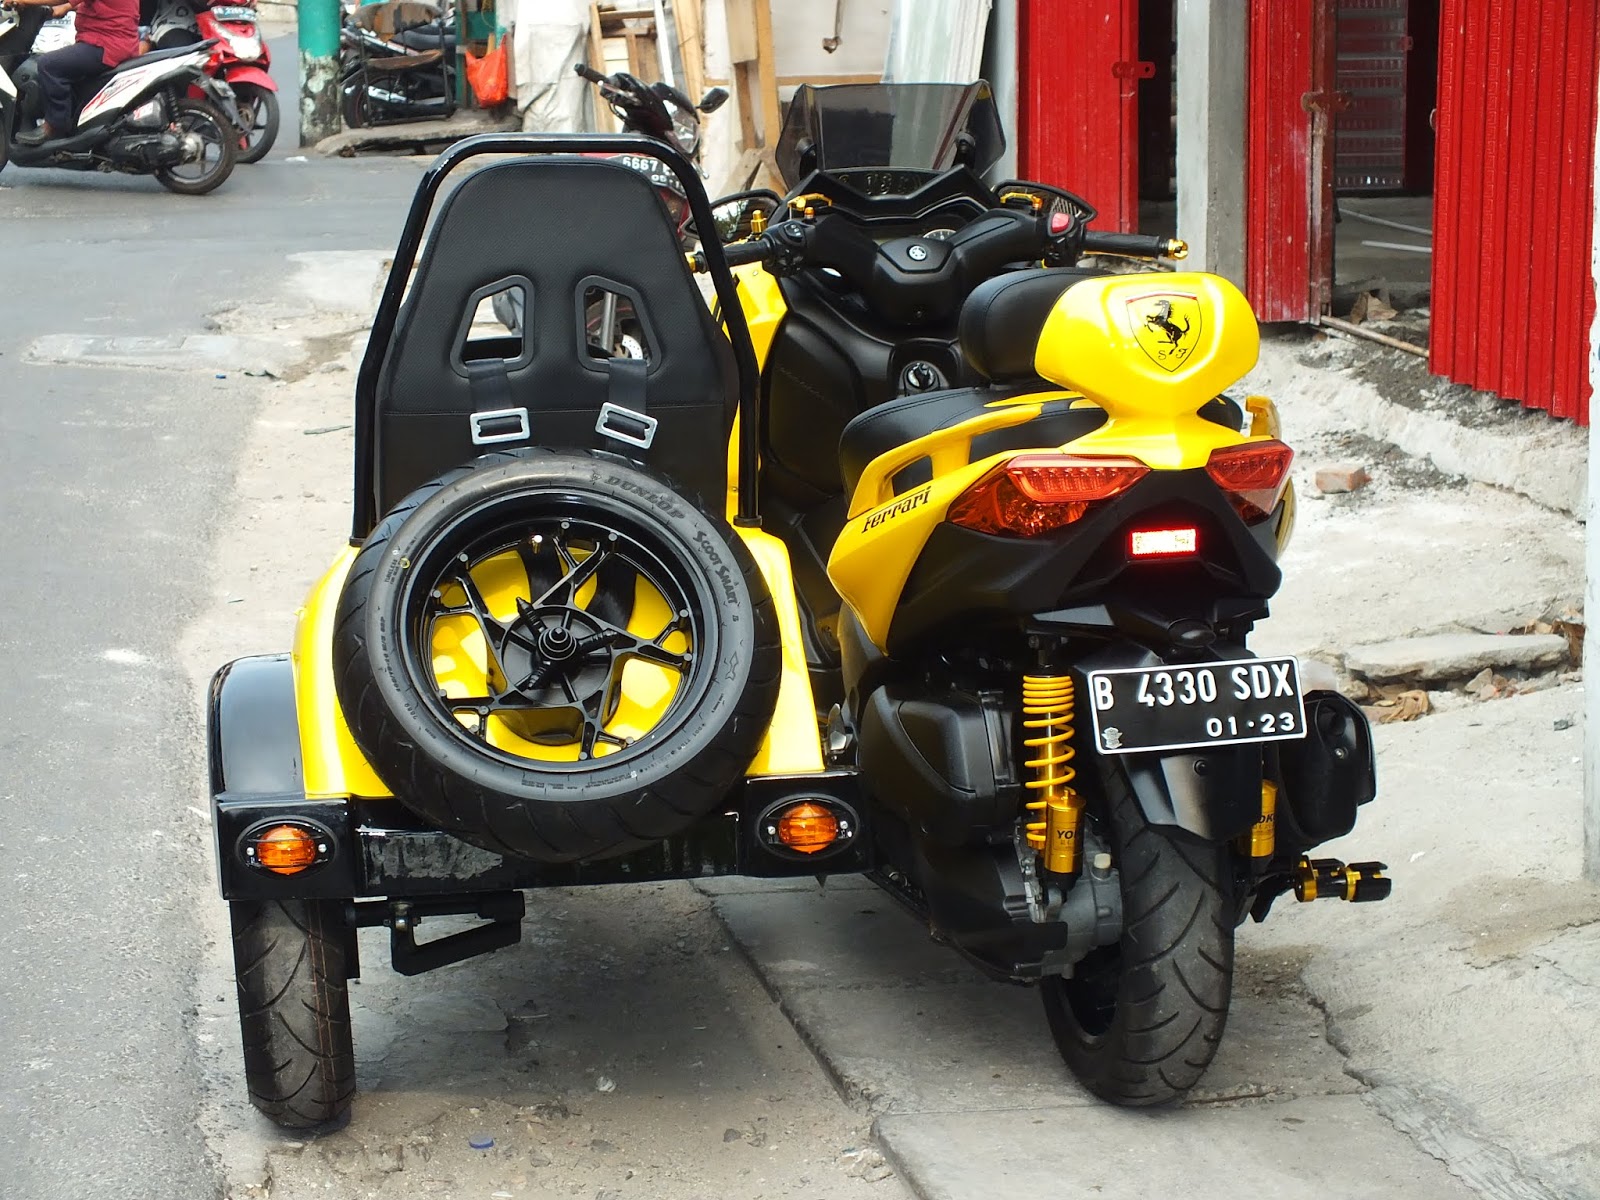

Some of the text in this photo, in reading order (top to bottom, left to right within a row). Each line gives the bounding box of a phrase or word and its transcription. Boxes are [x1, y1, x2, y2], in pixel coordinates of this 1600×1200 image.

[622, 157, 659, 172] 6667
[1157, 350, 1167, 360] S
[604, 476, 686, 518] DUNLOP
[861, 485, 932, 534] Ferrari
[1093, 663, 1294, 711] B 4330 SDX
